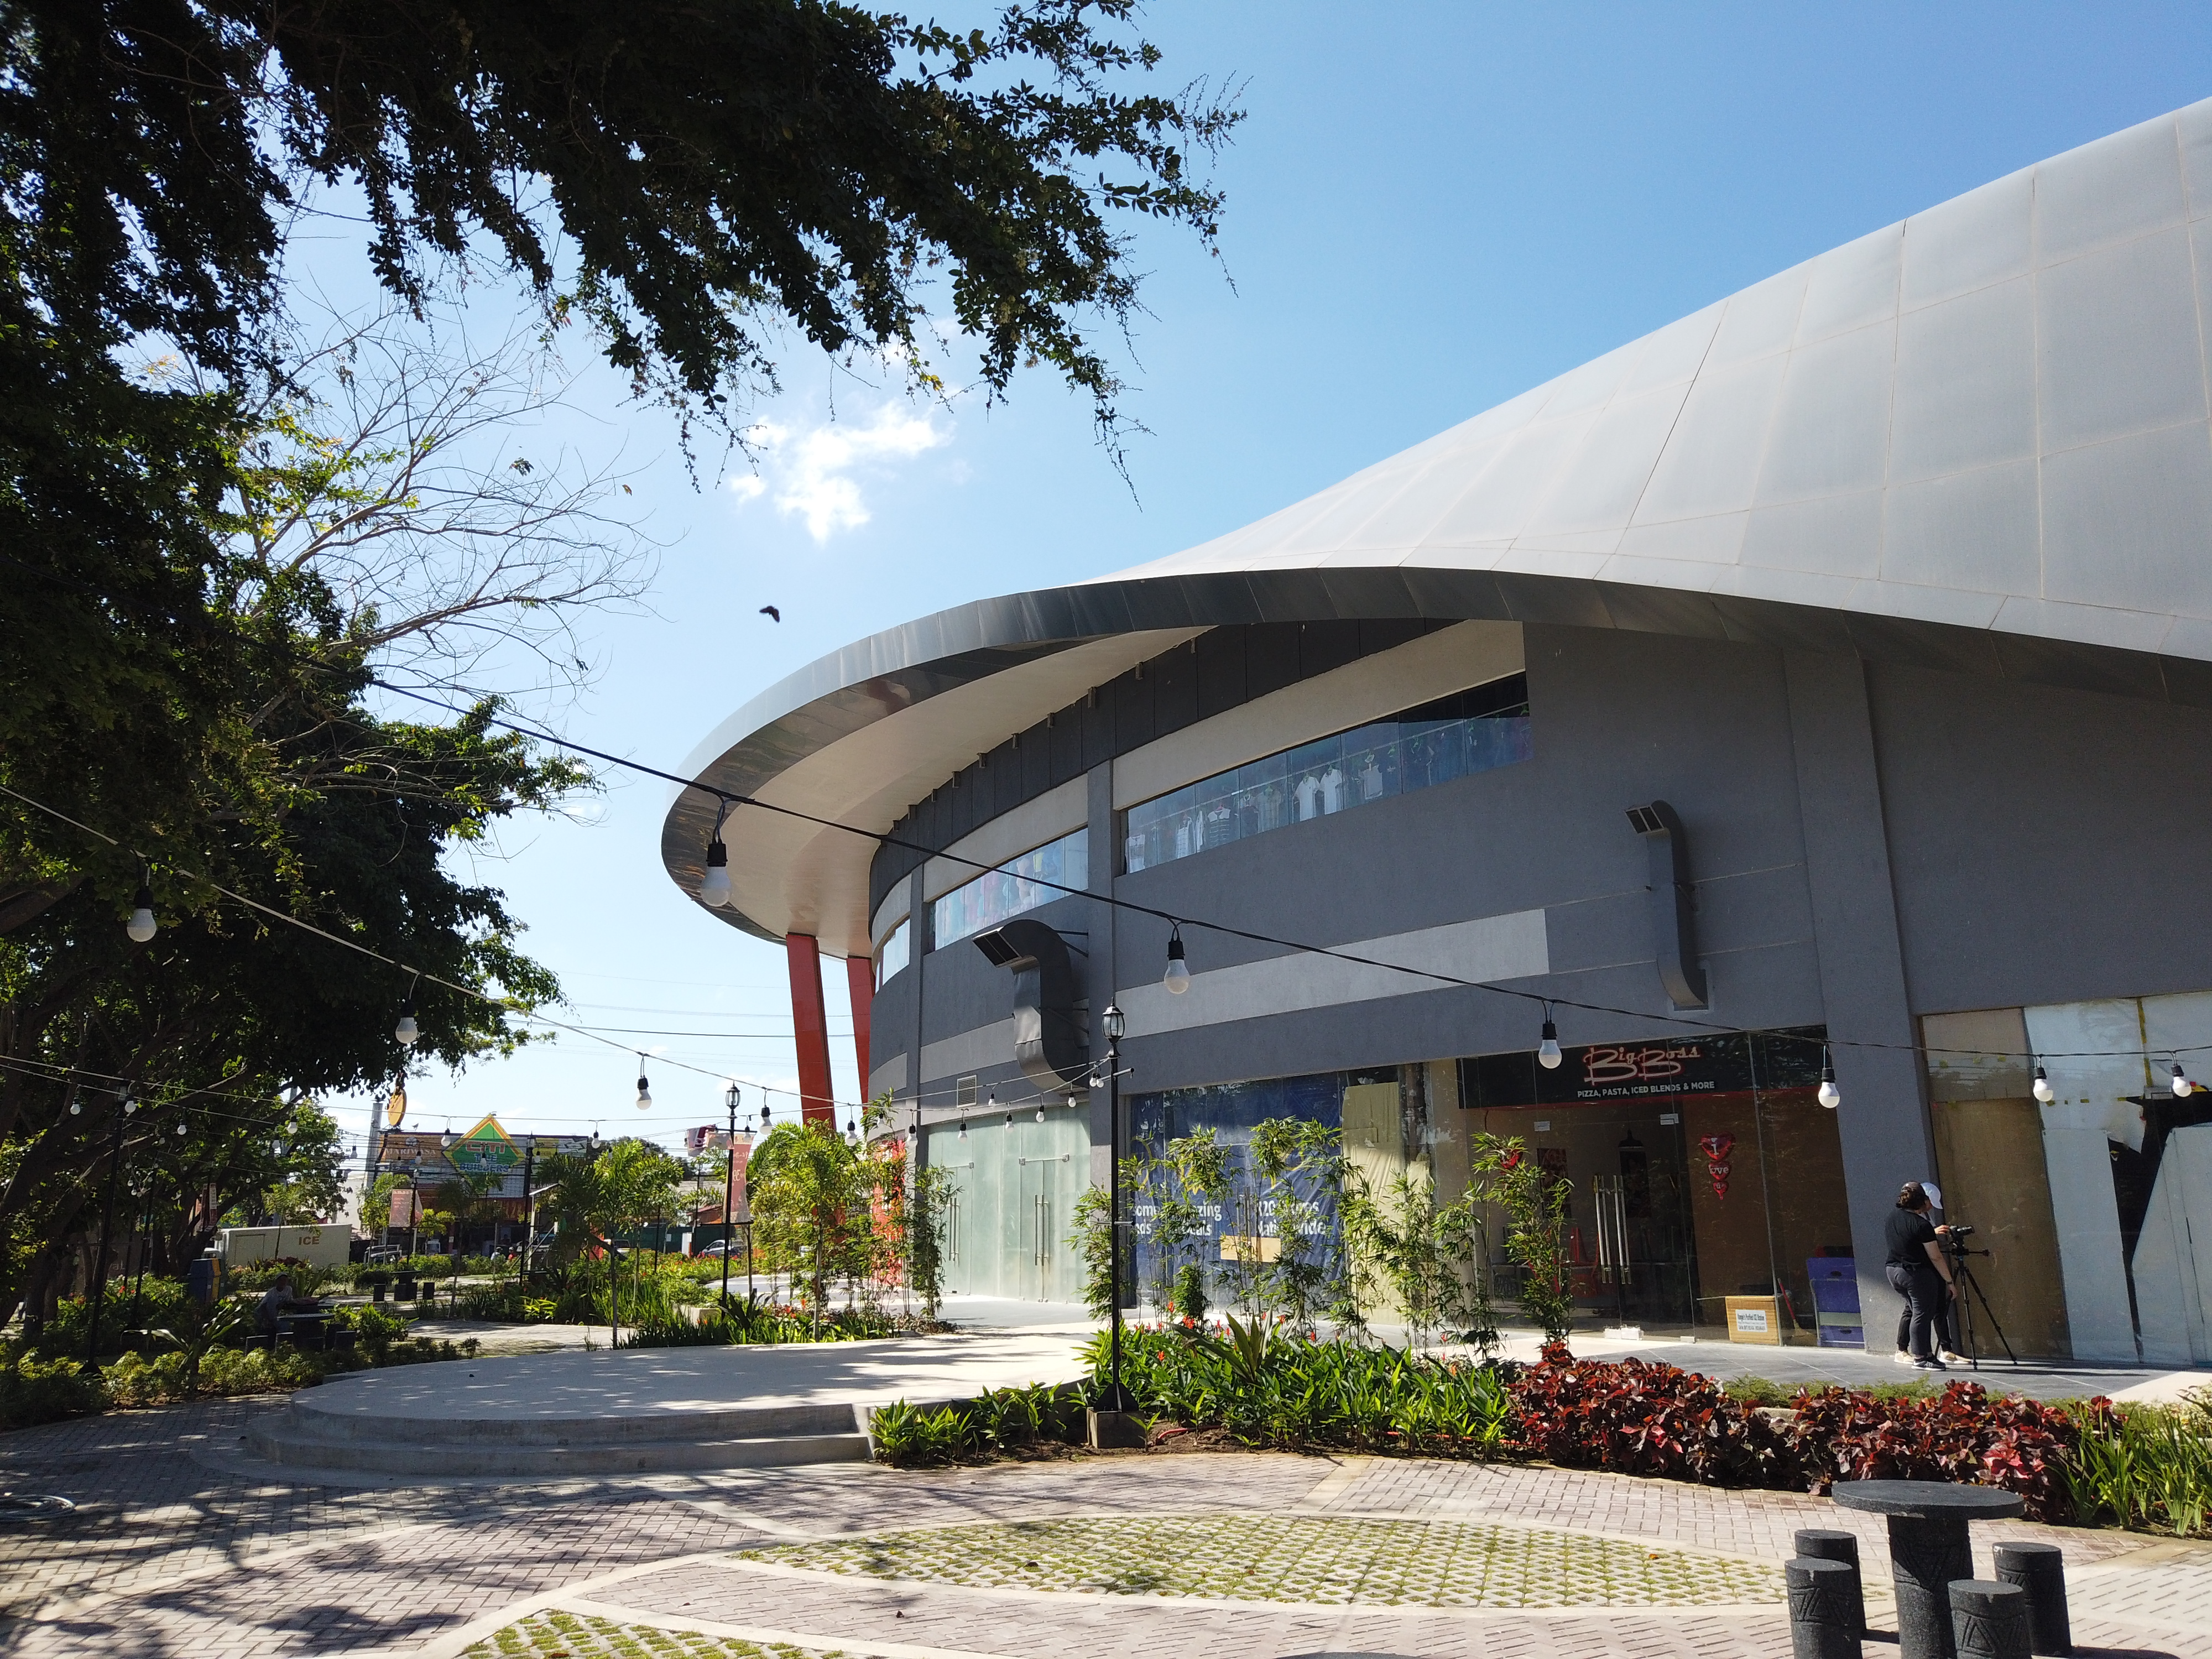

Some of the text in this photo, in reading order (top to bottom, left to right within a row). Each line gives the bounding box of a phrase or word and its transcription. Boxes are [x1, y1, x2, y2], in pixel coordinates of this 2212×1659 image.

[1583, 1046, 1700, 1086] Big Boss
[1577, 1089, 1601, 1098] PIZZA,
[1603, 1088, 1630, 1096] PASTA,
[1631, 1086, 1648, 1094] ICED
[1651, 1083, 1681, 1093] BLENDS
[1691, 1081, 1715, 1089] MORE
[474, 1154, 497, 1163] TLE
[1708, 1164, 1729, 1174] love
[299, 1236, 320, 1245] ICE
